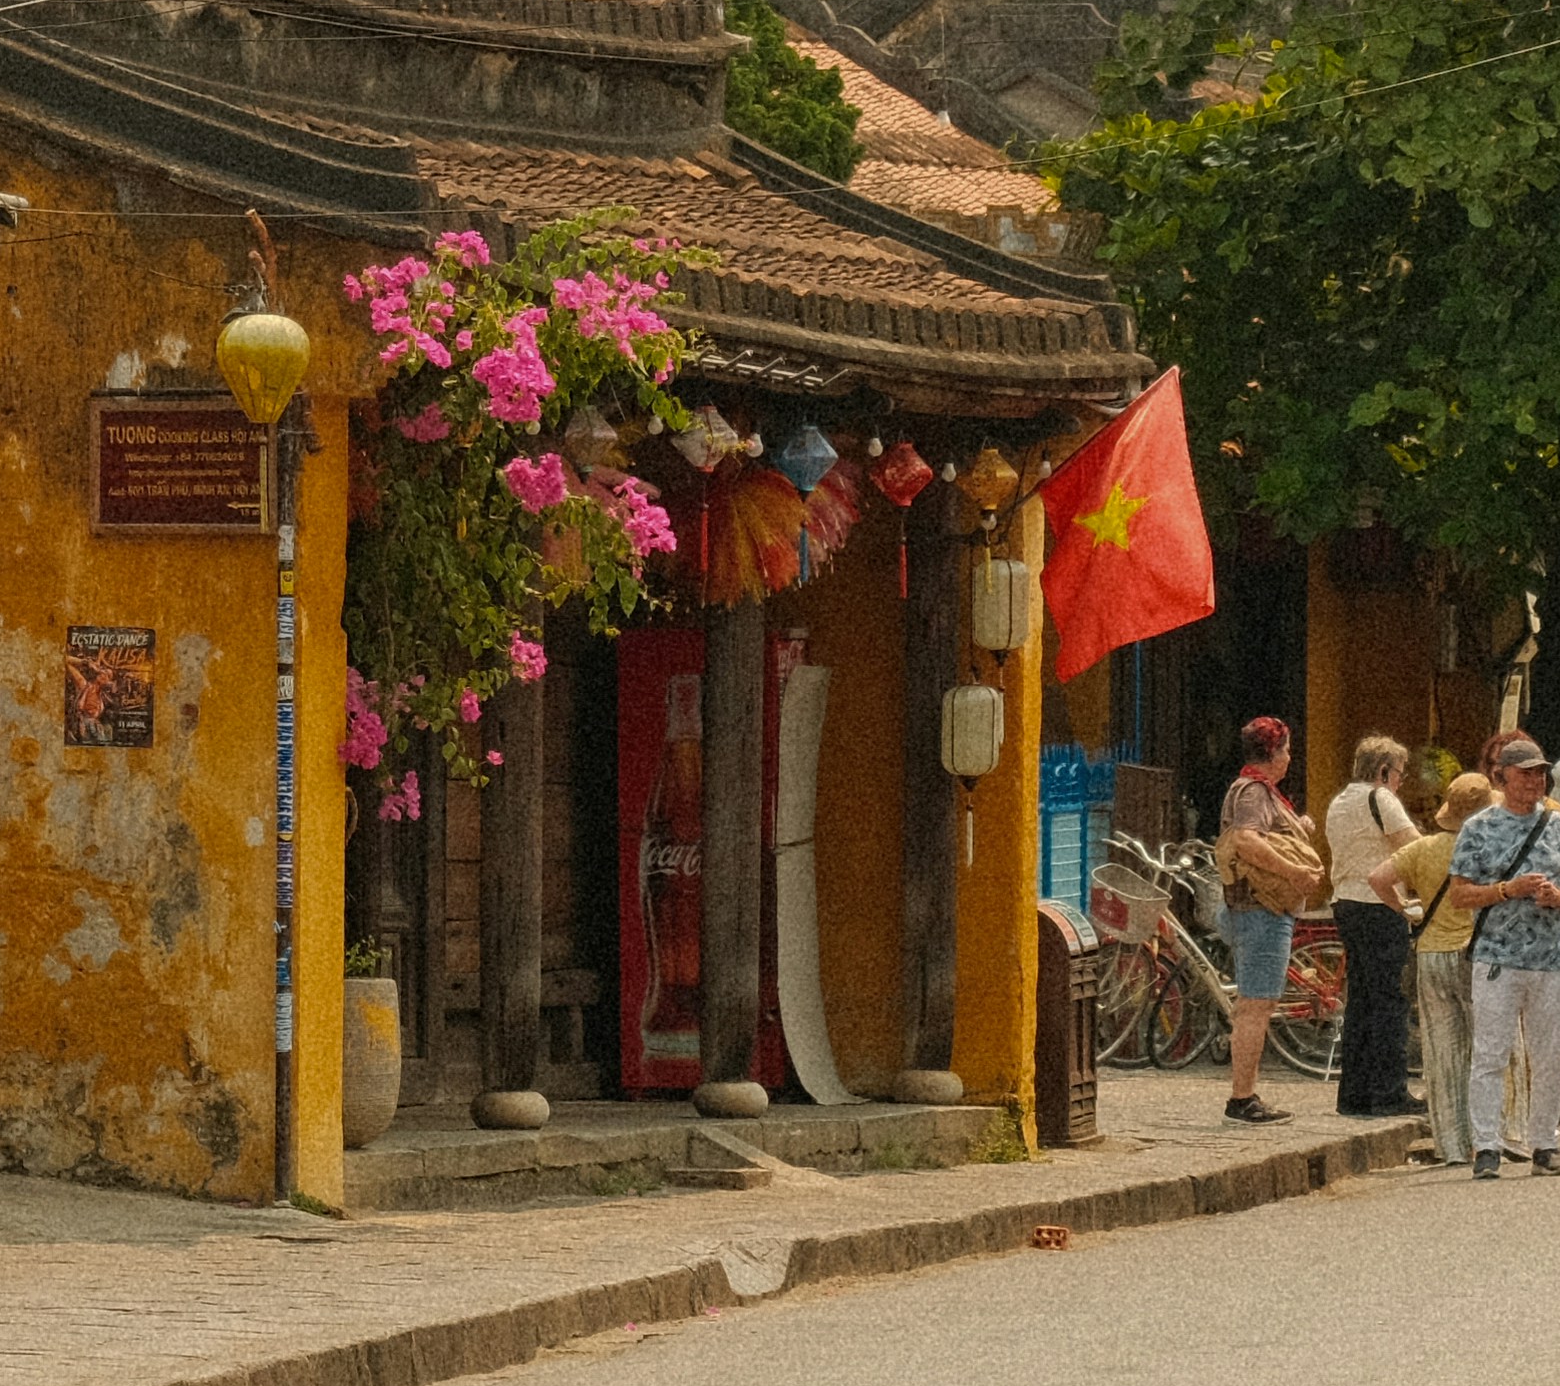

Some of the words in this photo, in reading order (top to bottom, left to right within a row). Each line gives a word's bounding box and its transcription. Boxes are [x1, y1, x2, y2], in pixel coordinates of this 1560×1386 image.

[158, 431, 199, 444] COOKING
[200, 430, 230, 444] CLASS
[71, 632, 116, 646] ECSTATIC
[116, 633, 150, 647] DANCE
